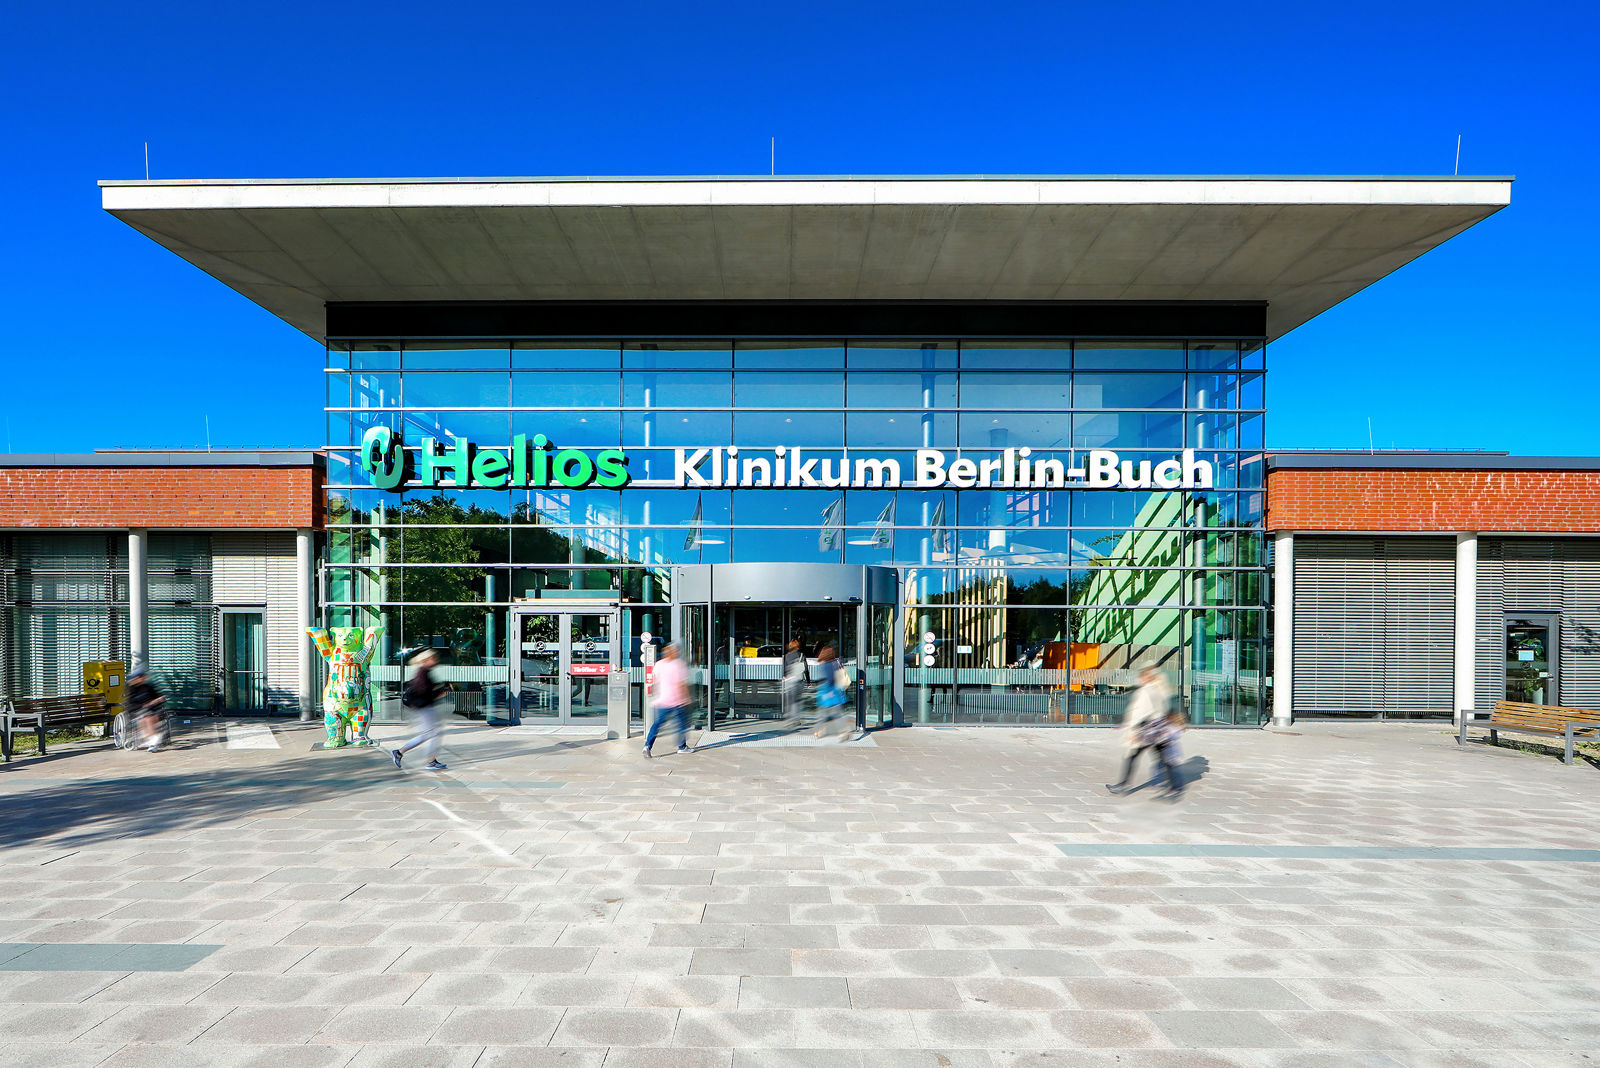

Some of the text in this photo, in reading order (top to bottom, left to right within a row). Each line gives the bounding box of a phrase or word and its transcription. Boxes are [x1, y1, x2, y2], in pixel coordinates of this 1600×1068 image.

[421, 433, 1214, 489] Helios Klinikum Berlin-Buch
